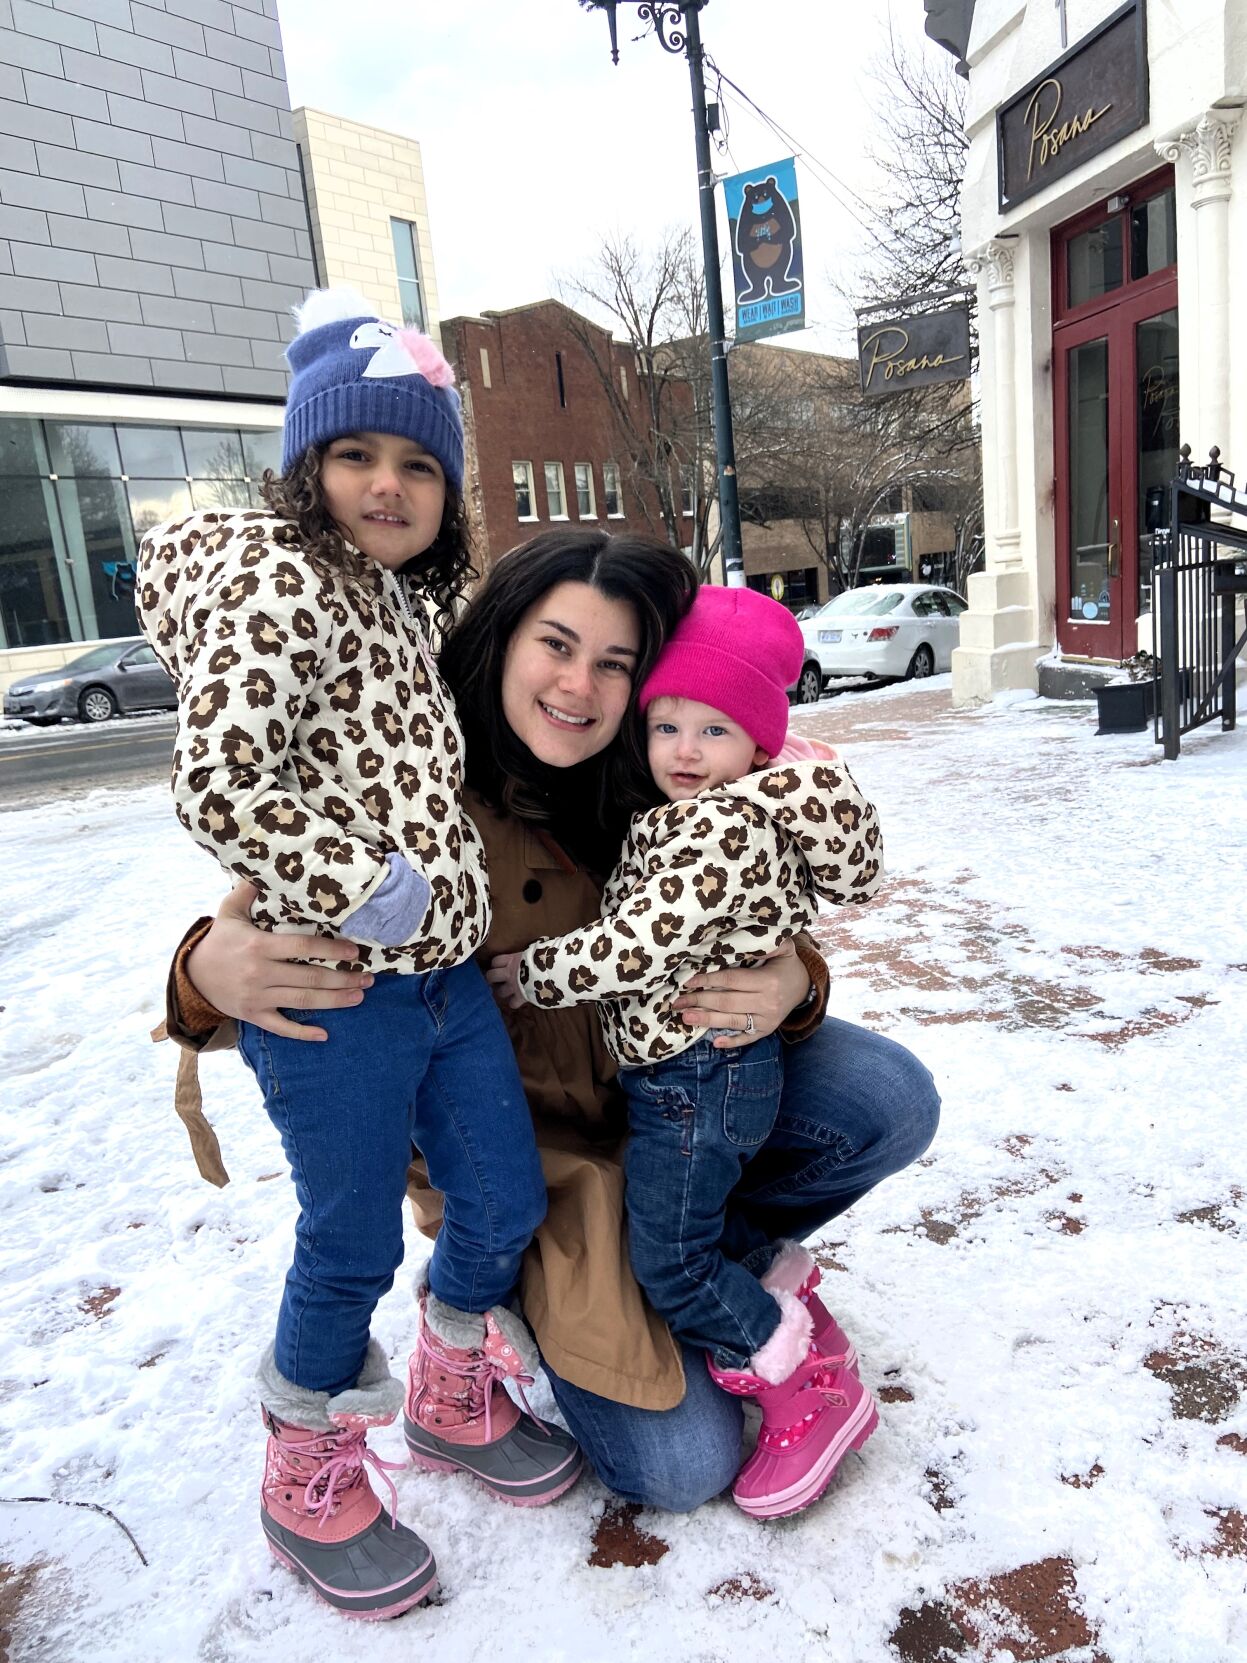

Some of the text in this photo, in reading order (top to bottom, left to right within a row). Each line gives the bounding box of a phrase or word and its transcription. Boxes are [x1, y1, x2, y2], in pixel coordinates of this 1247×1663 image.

[1023, 78, 1112, 182] Posana
[742, 306, 759, 321] WEAR
[781, 296, 799, 311] WASH
[862, 327, 965, 389] Posana
